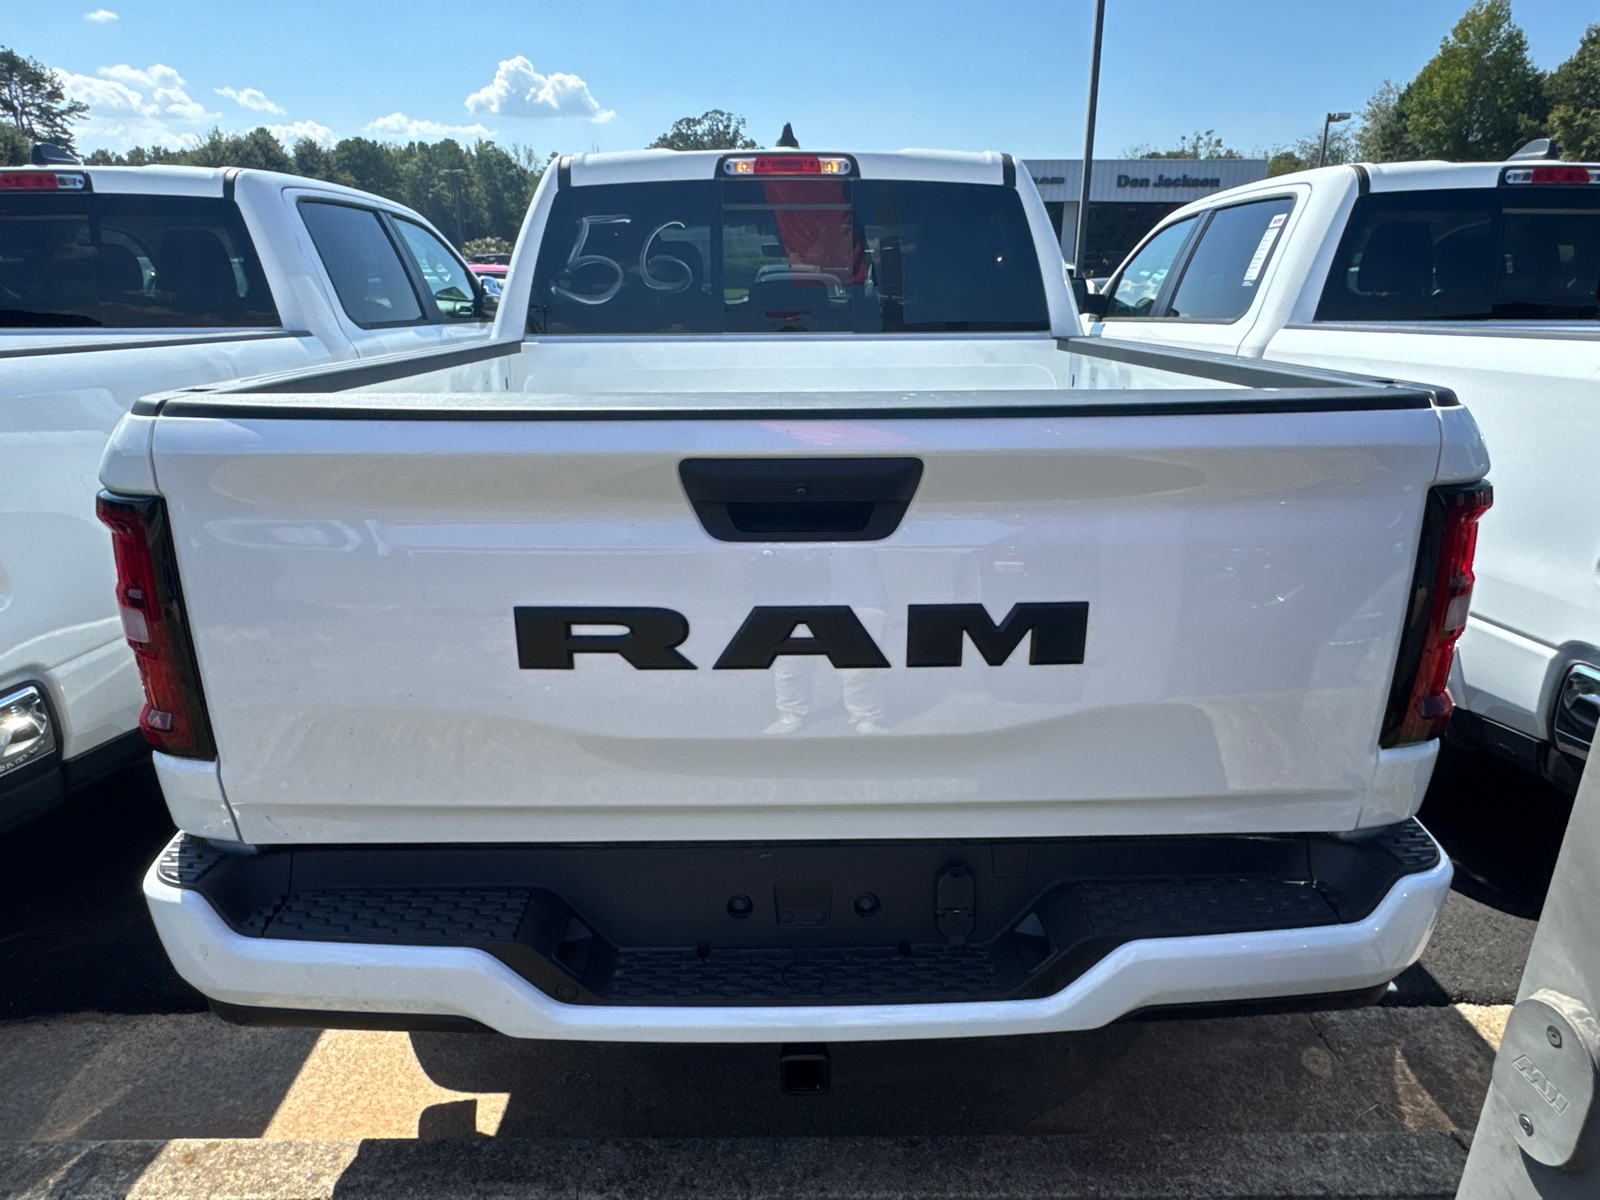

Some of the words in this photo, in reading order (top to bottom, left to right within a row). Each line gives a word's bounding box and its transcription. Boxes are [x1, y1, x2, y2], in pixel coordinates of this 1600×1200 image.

[1116, 174, 1150, 188] Don
[1152, 174, 1220, 188] Jackson
[550, 213, 695, 306] 56
[513, 601, 1090, 671] RAM
